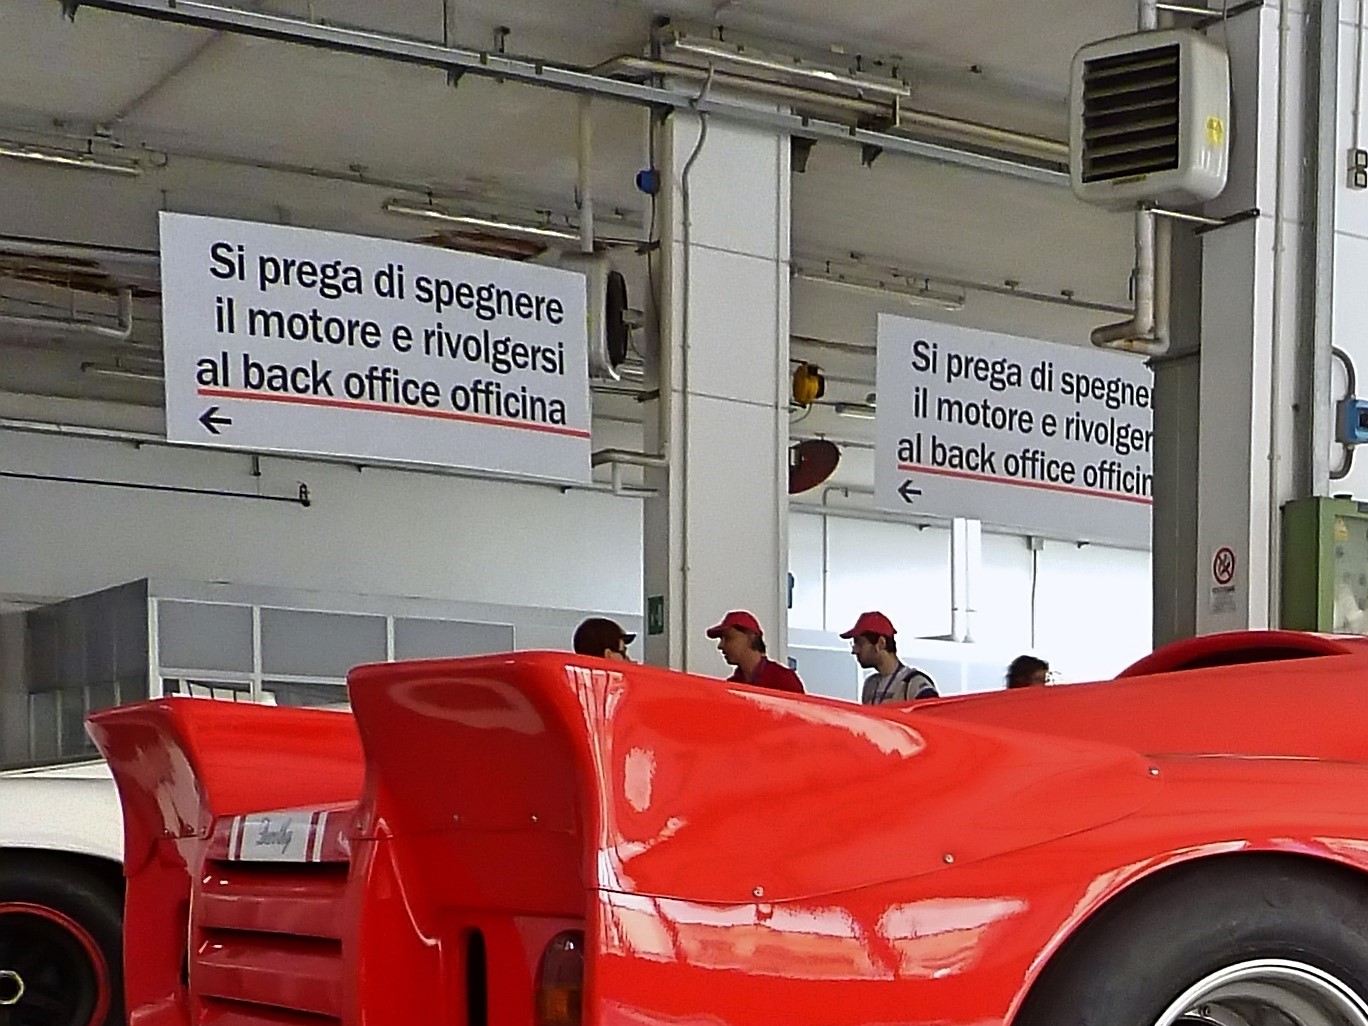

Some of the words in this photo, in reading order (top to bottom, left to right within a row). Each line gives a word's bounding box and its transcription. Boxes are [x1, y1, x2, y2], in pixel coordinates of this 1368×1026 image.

[210, 242, 244, 281] Si
[259, 254, 362, 299] prega
[375, 264, 404, 299] di
[415, 275, 564, 325] spegnere
[216, 297, 234, 333] il
[249, 308, 381, 348] motore
[393, 325, 412, 352] e
[424, 322, 564, 375] rivolgersi
[197, 351, 229, 387] al
[243, 354, 334, 396] back
[344, 366, 440, 407] office
[451, 381, 567, 425] officina
[911, 340, 938, 374] Si
[946, 352, 1022, 391] prega
[1031, 361, 1053, 392] di
[1061, 370, 1153, 409] spegne
[914, 387, 927, 418] il
[938, 397, 1033, 434] motore
[1042, 414, 1057, 437] e
[1065, 412, 1153, 455] rivolger
[898, 433, 921, 463] al
[931, 435, 996, 474] back
[1004, 449, 1075, 484] office
[1083, 460, 1153, 496] officin
